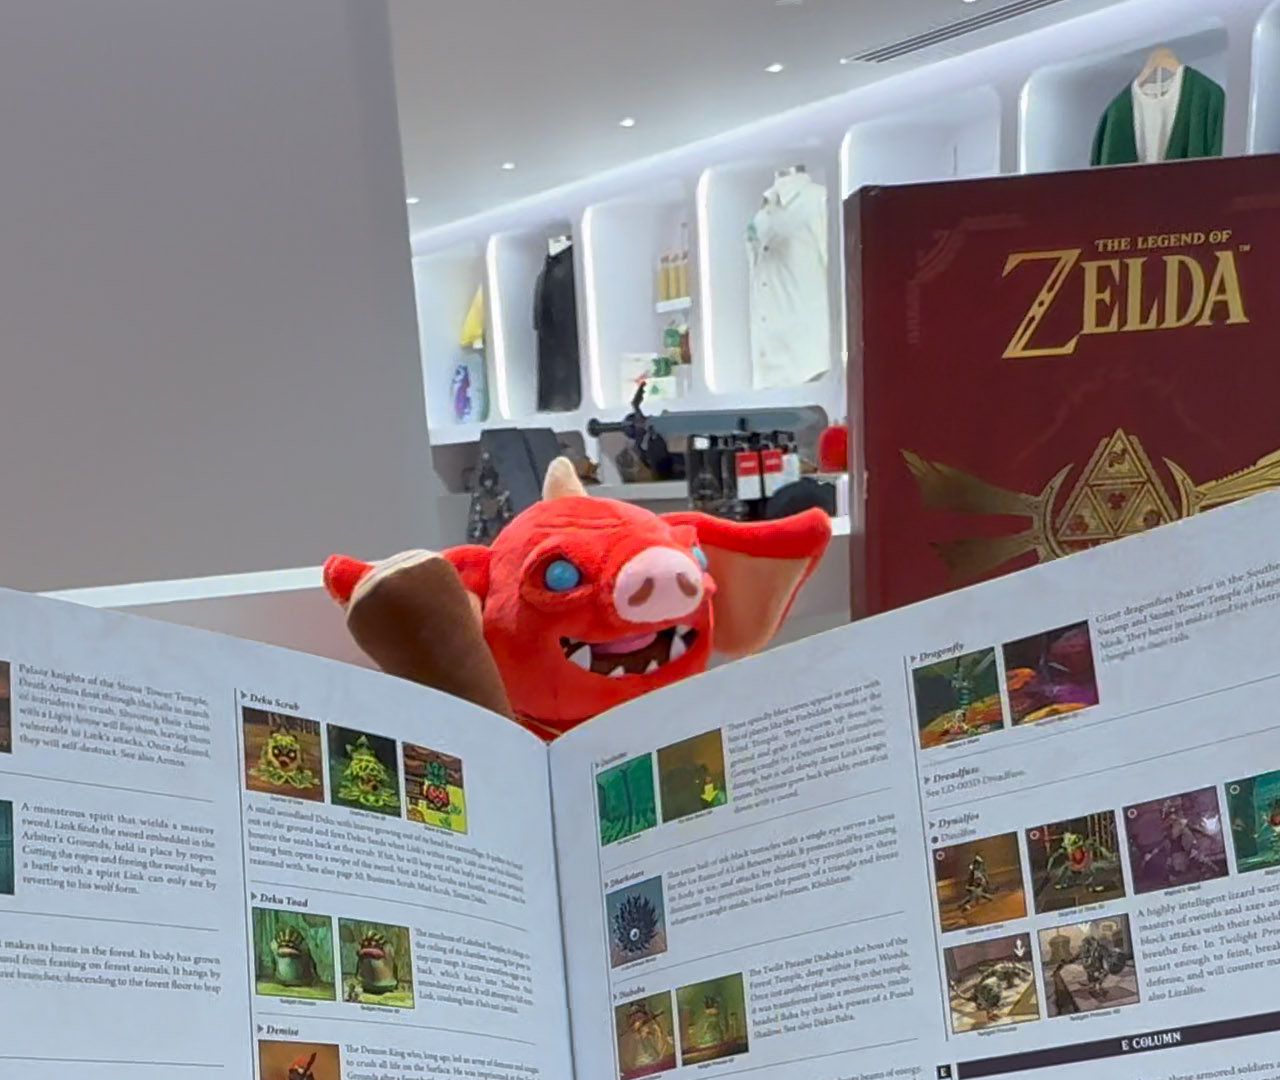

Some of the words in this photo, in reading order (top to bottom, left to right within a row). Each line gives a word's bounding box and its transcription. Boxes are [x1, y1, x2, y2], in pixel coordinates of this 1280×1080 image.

[1096, 238, 1131, 252] THE
[1138, 232, 1204, 249] LEGEND
[1210, 230, 1232, 244] OF
[1002, 248, 1250, 359] ZELDA
[919, 641, 964, 661] Dragonfly
[266, 1024, 298, 1036] Demise
[1121, 1039, 1129, 1050] E
[1132, 1031, 1180, 1048] COLUMN
[940, 1067, 948, 1076] E
